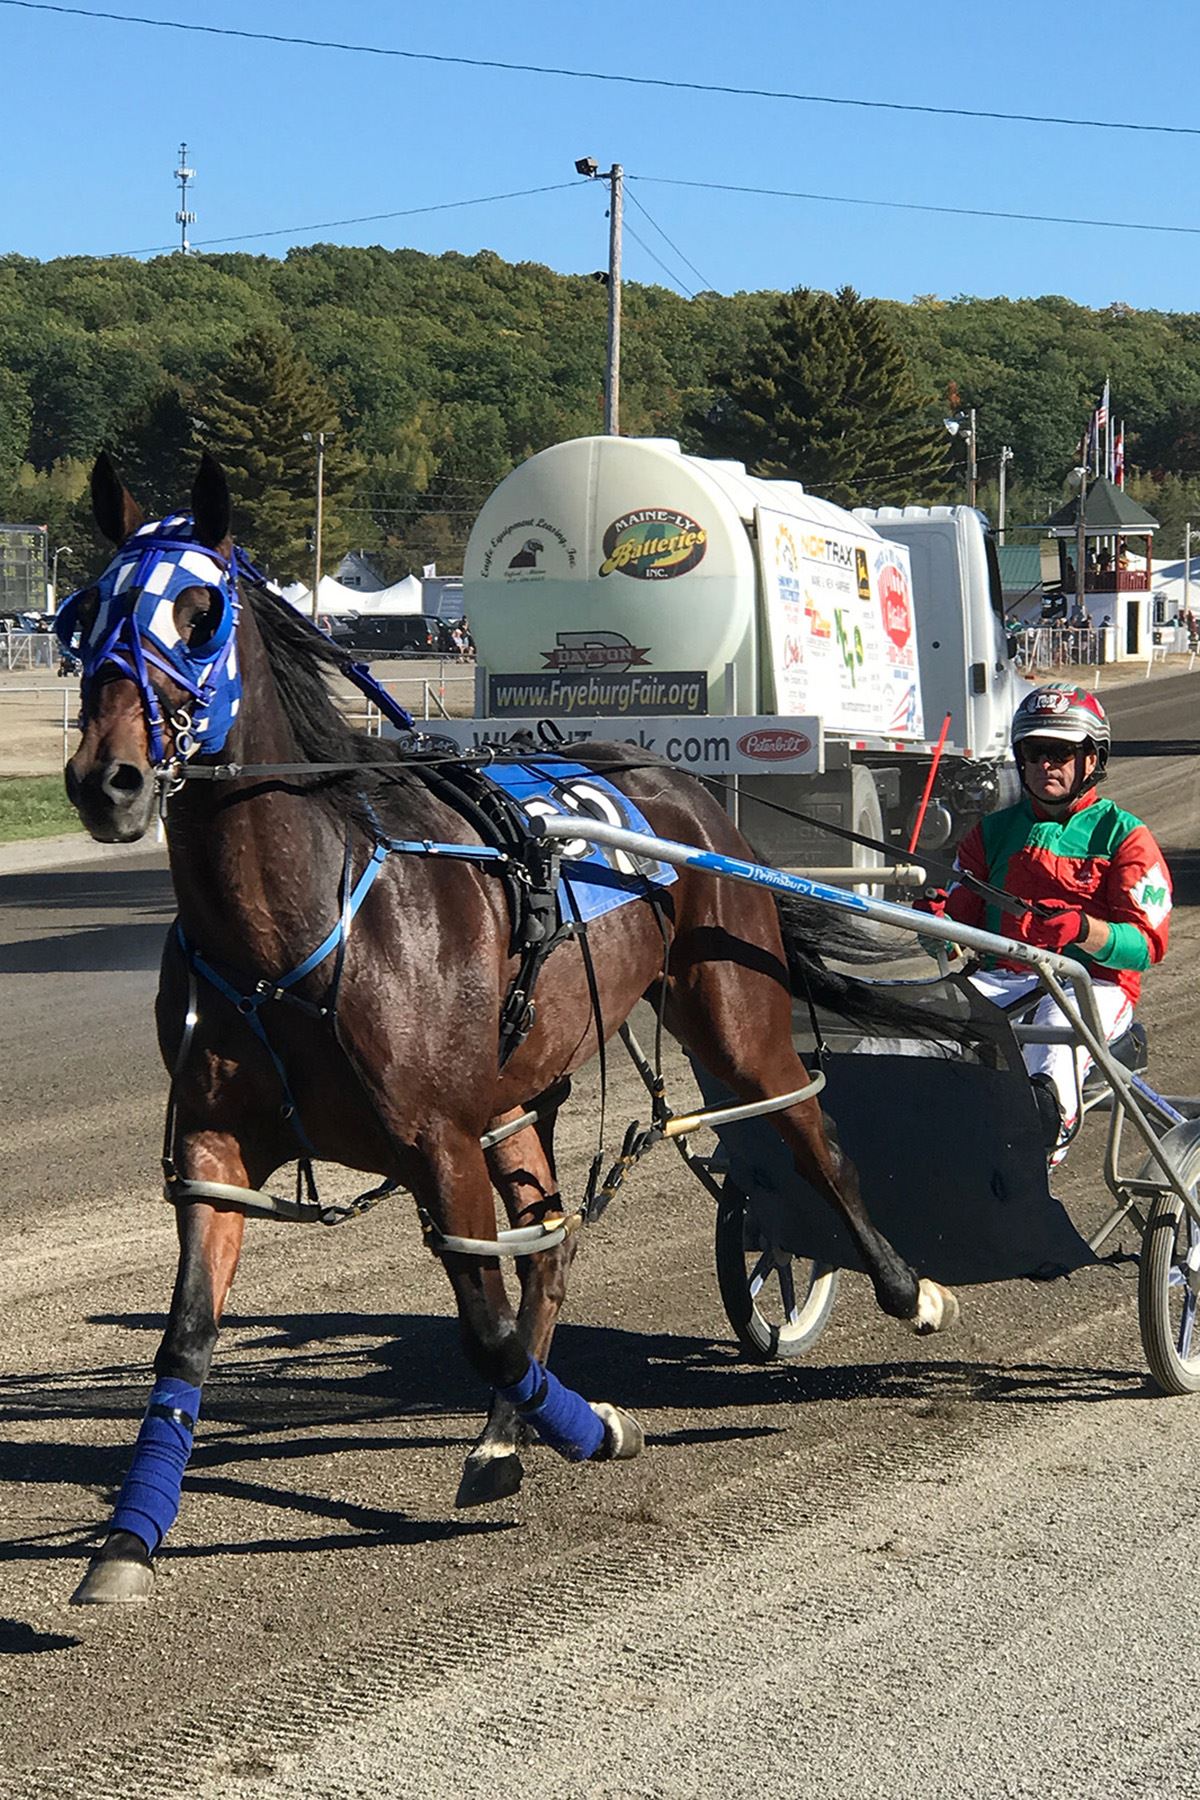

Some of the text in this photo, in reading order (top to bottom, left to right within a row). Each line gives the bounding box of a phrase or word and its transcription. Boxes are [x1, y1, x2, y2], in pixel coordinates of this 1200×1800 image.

[615, 511, 695, 532] MAINE-LY
[600, 529, 705, 576] Batteries
[646, 569, 668, 577] INC.
[558, 648, 632, 663] DAYTON
[496, 678, 700, 712] www.FryeburgFair.org
[747, 735, 805, 754] Peterbilt
[753, 867, 810, 893] Pennsbury
[1141, 885, 1166, 907] M
